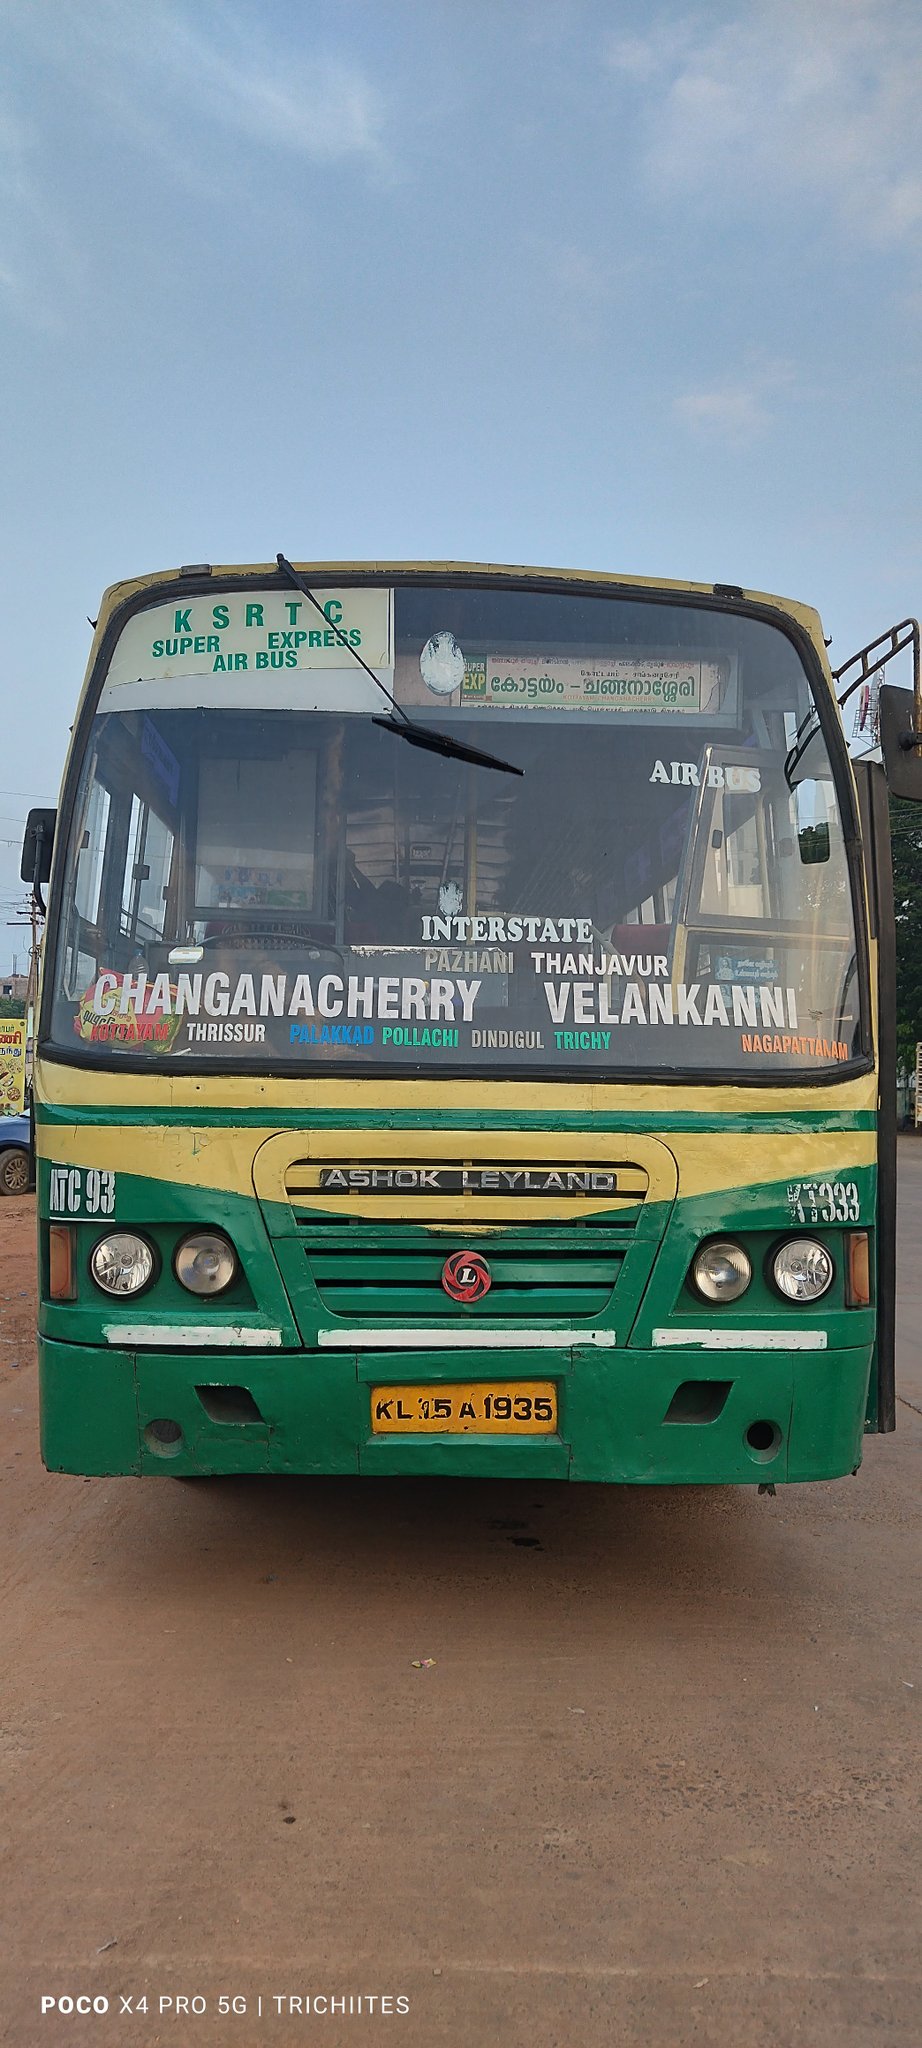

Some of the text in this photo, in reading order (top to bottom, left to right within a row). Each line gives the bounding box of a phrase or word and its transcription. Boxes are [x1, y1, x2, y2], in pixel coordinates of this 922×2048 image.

[152, 629, 362, 658] SUPER EXPRESS
[212, 650, 298, 673] AIR BUS
[462, 673, 486, 690] EXP
[490, 676, 565, 698] കോട്ടയം
[649, 760, 762, 793] AIR BUS
[421, 915, 594, 944] INTERSTATE
[424, 951, 669, 977] PAZHANI THANJAVUR
[93, 972, 798, 1030] CHANGANACHERRY VELANKANNI
[90, 1022, 849, 1061] KOTTAYAM THRISSUR PALAKKAD POLLACHI DINDIGUL TRICHY NAGAPATTANAM
[50, 1169, 116, 1214] ATC 93
[324, 1169, 614, 1191] ASHOK LEYLAND
[458, 1402, 476, 1419] A
[483, 1397, 553, 1421] 1935
